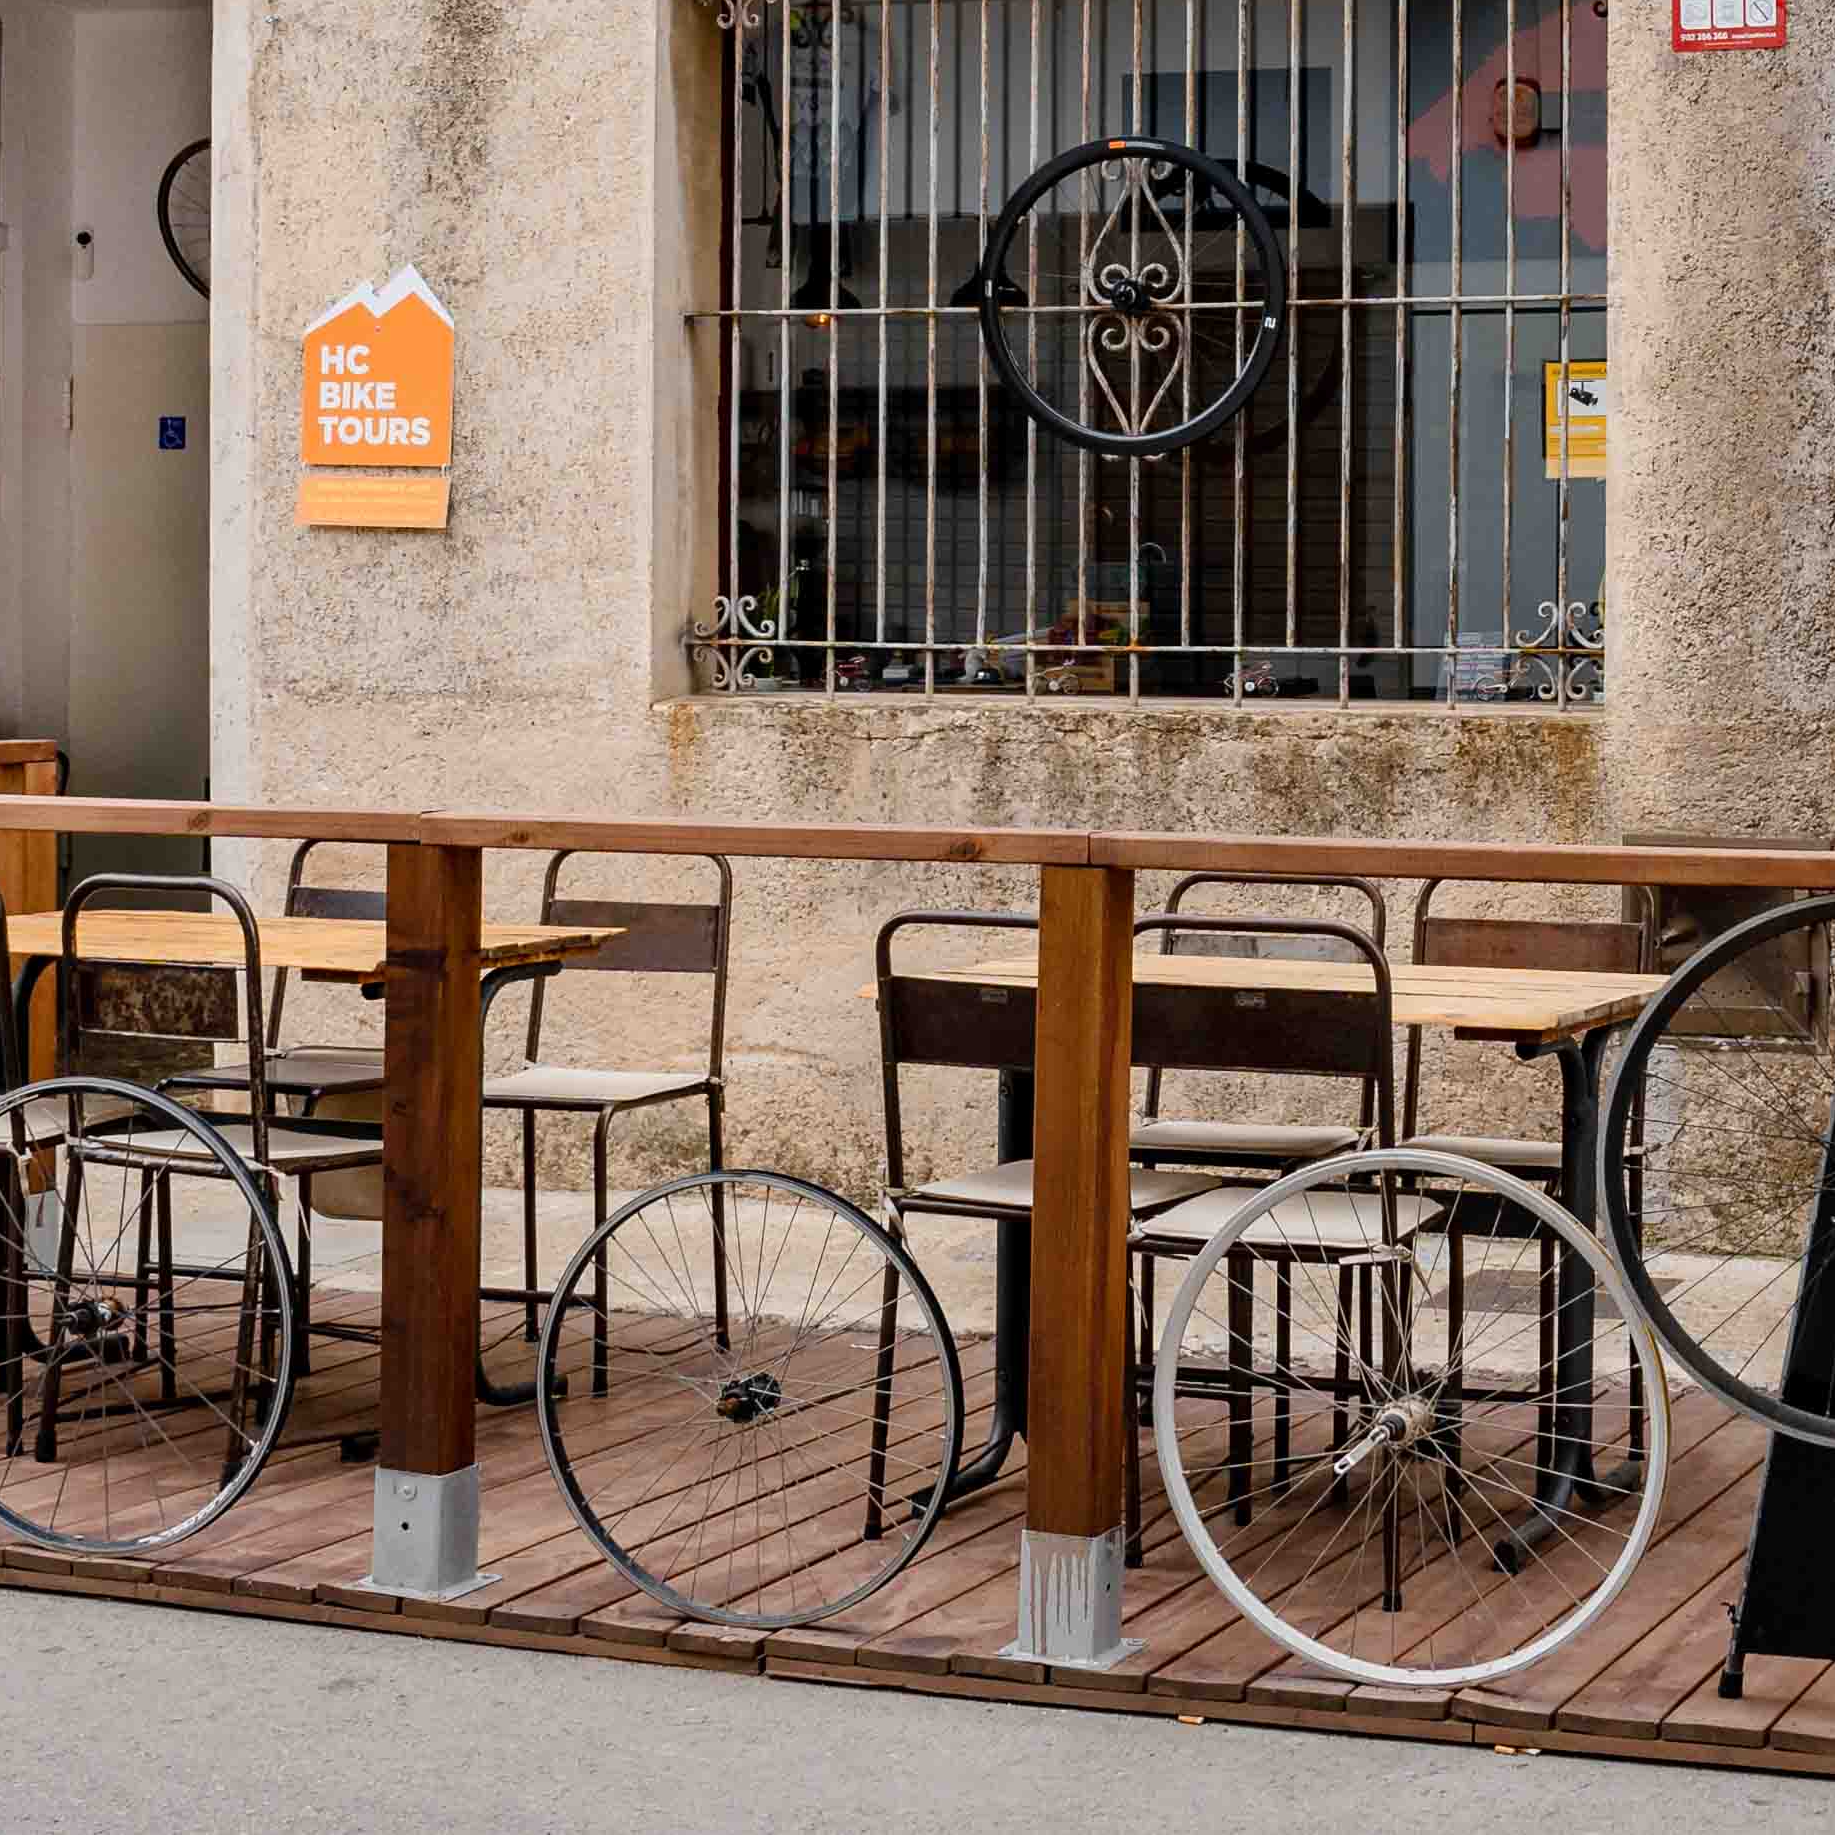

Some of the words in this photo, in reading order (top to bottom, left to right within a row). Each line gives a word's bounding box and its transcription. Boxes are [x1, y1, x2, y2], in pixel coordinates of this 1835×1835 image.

[320, 344, 370, 375] HC
[319, 381, 397, 411] BIKE
[318, 415, 431, 447] TOURS
